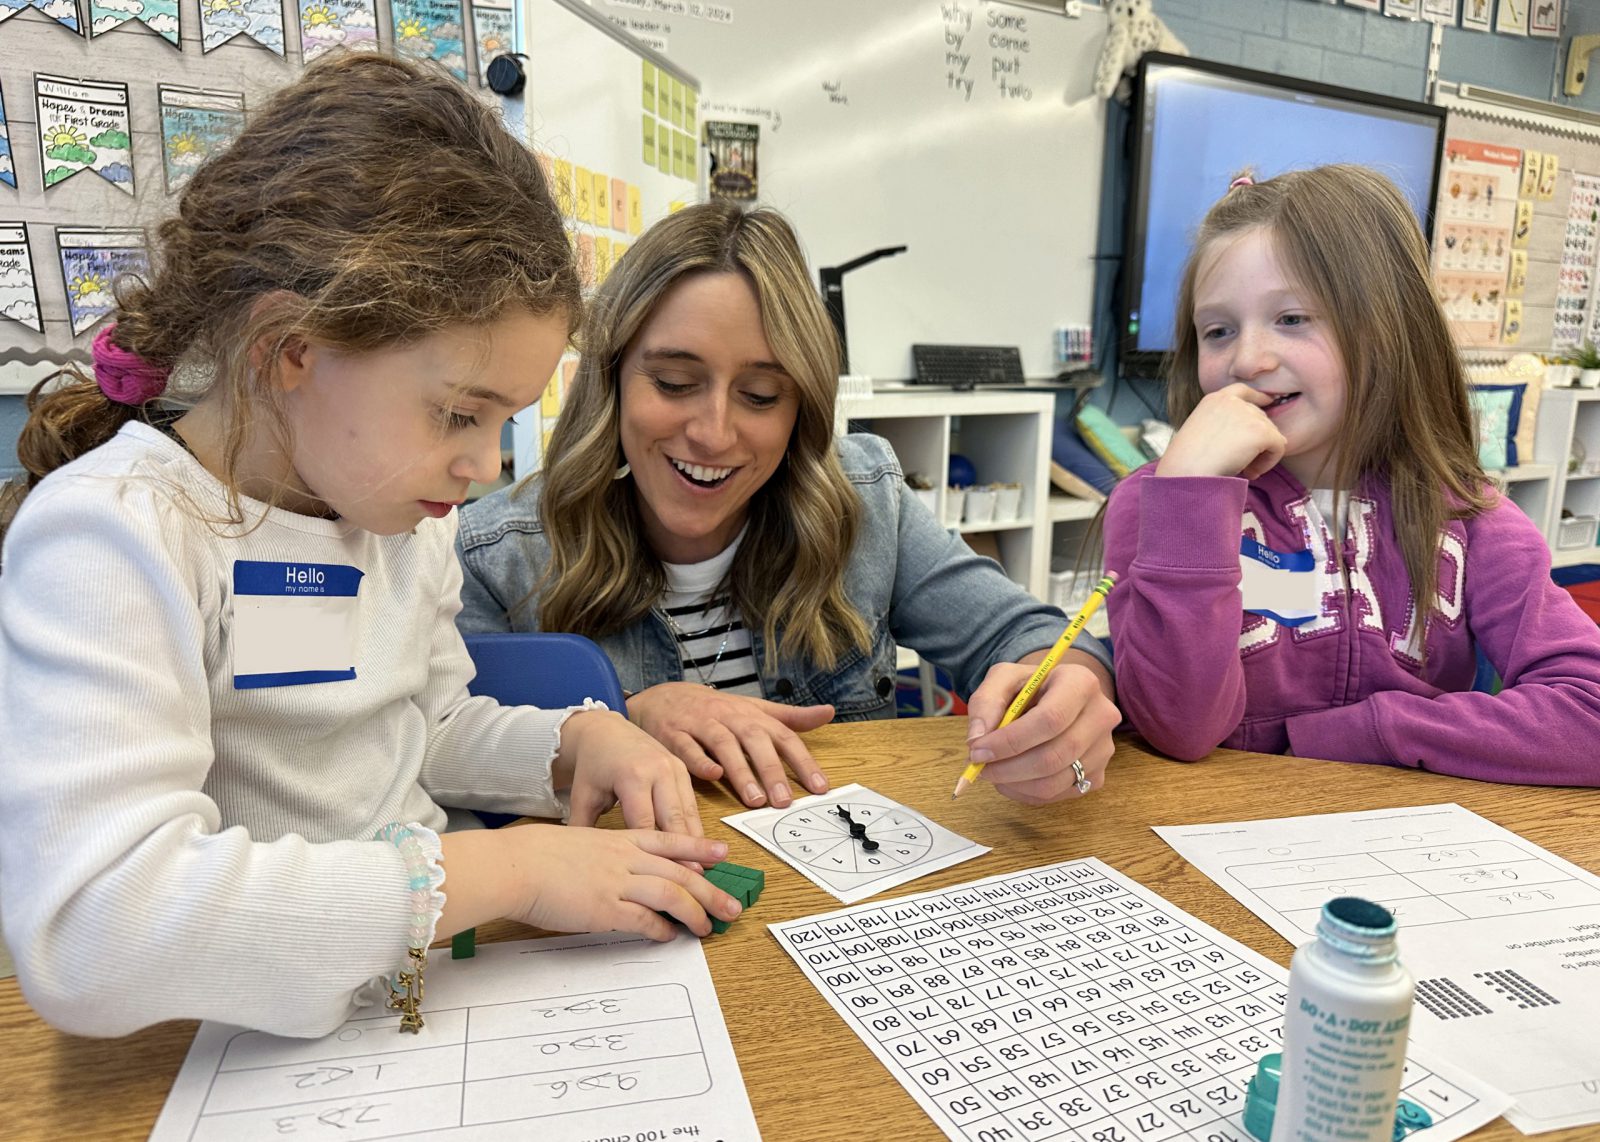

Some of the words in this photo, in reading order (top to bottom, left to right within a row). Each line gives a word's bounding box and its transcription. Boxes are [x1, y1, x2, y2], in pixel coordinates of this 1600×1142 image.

[945, 24, 964, 52] by
[946, 51, 971, 75] my
[992, 56, 1020, 81] put
[946, 70, 975, 102] try
[999, 75, 1033, 101] two
[42, 98, 76, 114] Hopes
[89, 106, 125, 117] Dreams
[1257, 544, 1280, 564] Hello
[286, 566, 325, 584] Hello
[285, 585, 296, 594] my
[799, 845, 812, 853] 2
[1040, 875, 1067, 885] 112
[1070, 869, 1094, 878] 111
[1012, 881, 1039, 892] 113
[1092, 884, 1119, 894] 101
[954, 894, 981, 906] 115
[983, 888, 1010, 899] 114
[1062, 891, 1092, 901] 102
[922, 902, 950, 913] 116
[1034, 897, 1063, 908] 103
[1120, 901, 1143, 910] 91
[895, 908, 919, 921] 117
[1004, 904, 1034, 916] 104
[1090, 908, 1115, 917] 92
[859, 916, 888, 928] 118
[974, 912, 1004, 924] 105
[1062, 915, 1086, 925] 93
[825, 923, 855, 935] 119
[942, 919, 973, 931] 106
[1031, 923, 1056, 933] 94
[790, 930, 822, 943] 120
[914, 927, 942, 942] 107
[1000, 930, 1025, 941] 95
[1174, 933, 1198, 944] 71
[877, 935, 909, 948] 108
[968, 939, 994, 949] 96
[1142, 941, 1169, 952] 72
[1523, 938, 1565, 948] number
[842, 942, 875, 956] 109
[940, 947, 961, 958] 97
[1113, 950, 1139, 961] 73
[809, 950, 840, 964] 110
[901, 956, 928, 966] 98
[866, 964, 893, 976] 99
[1082, 958, 1108, 971] 74
[827, 972, 860, 986] 100
[1050, 967, 1076, 980] 75
[1016, 976, 1043, 989] 76
[986, 986, 1010, 1000] 77
[946, 996, 974, 1009] 78
[909, 1006, 939, 1020] 79
[1236, 1004, 1266, 1016] 42
[873, 1016, 900, 1031] 80
[1205, 1014, 1235, 1028] 43
[1347, 1018, 1381, 1033] DOT
[1172, 1026, 1203, 1039] 44
[1138, 1036, 1169, 1050] 45
[1239, 1036, 1268, 1052] 33
[1103, 1048, 1134, 1062] 46
[1206, 1048, 1236, 1064] 34
[1071, 1060, 1098, 1075] 47
[1171, 1060, 1202, 1077] 35
[1028, 1072, 1061, 1088] 48
[1135, 1072, 1166, 1088] 36
[988, 1085, 1022, 1100] 49
[1103, 1085, 1129, 1102] 37
[1206, 1086, 1238, 1106] 25
[950, 1096, 981, 1114] 50
[1059, 1098, 1092, 1116] 38
[1170, 1100, 1202, 1117] 26
[1018, 1112, 1052, 1130] 39
[1136, 1113, 1164, 1132] 27
[636, 1130, 667, 1142] 100
[673, 1125, 700, 1136] the
[978, 1127, 1013, 1142] 40
[1092, 1127, 1125, 1142] 28
